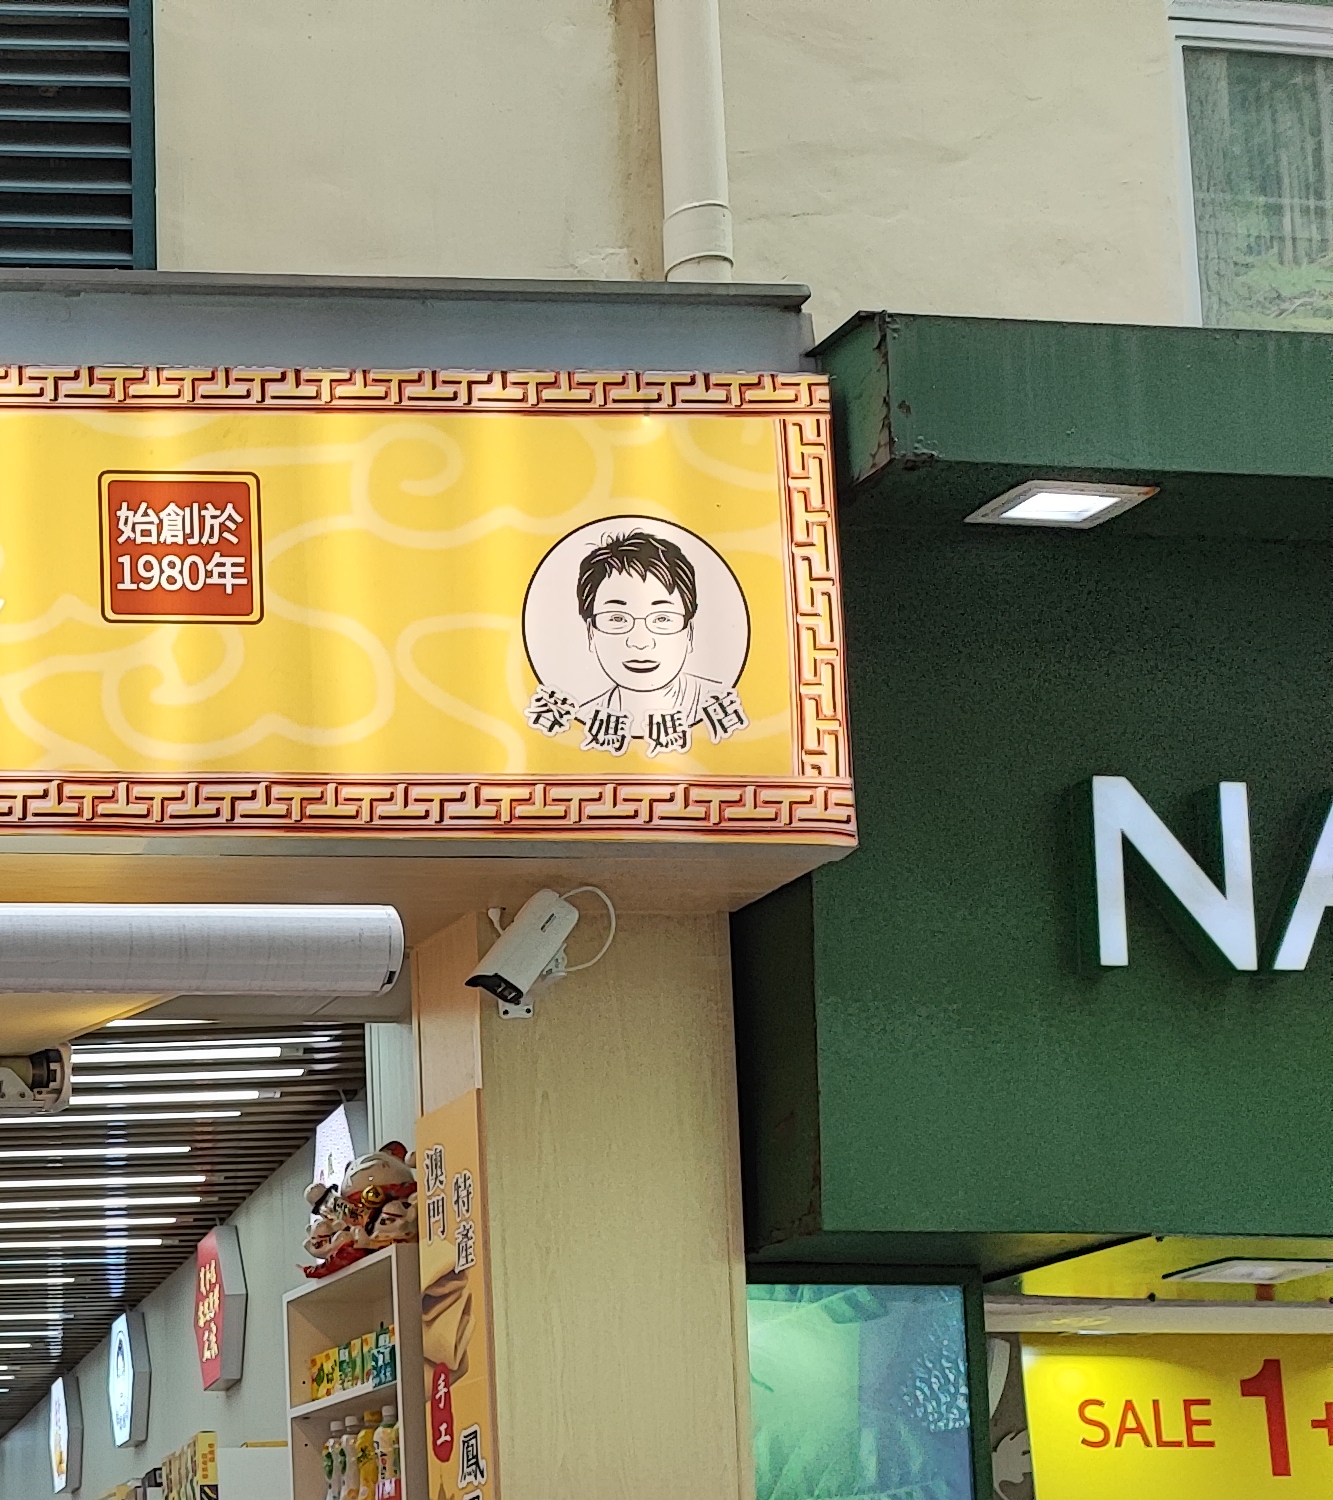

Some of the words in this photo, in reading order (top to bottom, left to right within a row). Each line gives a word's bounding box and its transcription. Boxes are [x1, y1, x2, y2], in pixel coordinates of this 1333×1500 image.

[116, 501, 244, 547] 始創於
[116, 552, 247, 594] 1980年
[425, 1146, 447, 1244] 澳門
[435, 1372, 452, 1445] 手工
[1078, 1399, 1215, 1448] SALE
